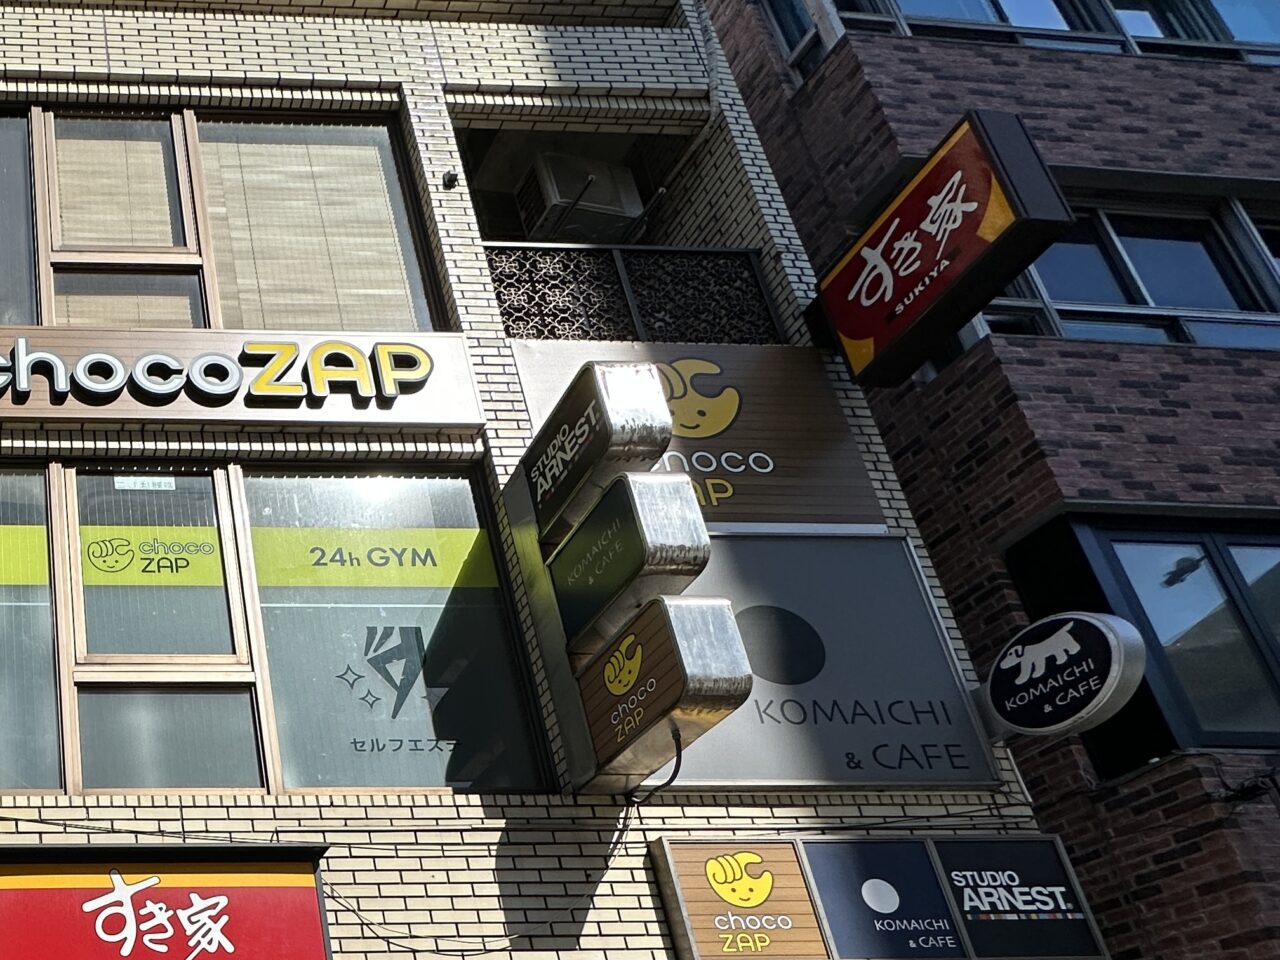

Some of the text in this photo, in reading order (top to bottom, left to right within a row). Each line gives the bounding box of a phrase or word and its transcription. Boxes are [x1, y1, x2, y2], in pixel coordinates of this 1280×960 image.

[846, 169, 978, 307] すき家
[892, 257, 952, 316] SUKIYA
[530, 424, 569, 482] STUDIO
[536, 400, 598, 502] ARNEST
[652, 451, 774, 473] hoco
[138, 537, 215, 557] choco
[309, 546, 438, 569] 24h GYM
[595, 538, 625, 575] CAFE
[140, 557, 190, 574] ZAP
[1004, 657, 1096, 711] KOMAICHI
[1043, 675, 1103, 713] & CAFE
[611, 678, 657, 725] choco
[754, 699, 953, 726] KOMAICHI
[614, 707, 644, 743] ZAP
[350, 737, 463, 754] セルフエステ
[846, 744, 970, 770] & CAFE
[950, 870, 1020, 887] STUDIO
[963, 885, 1067, 911] ARNEST
[713, 910, 793, 931] choco
[874, 918, 950, 932] KOMAICHI
[718, 932, 771, 953] ZAP
[908, 936, 957, 949] & CAFE
